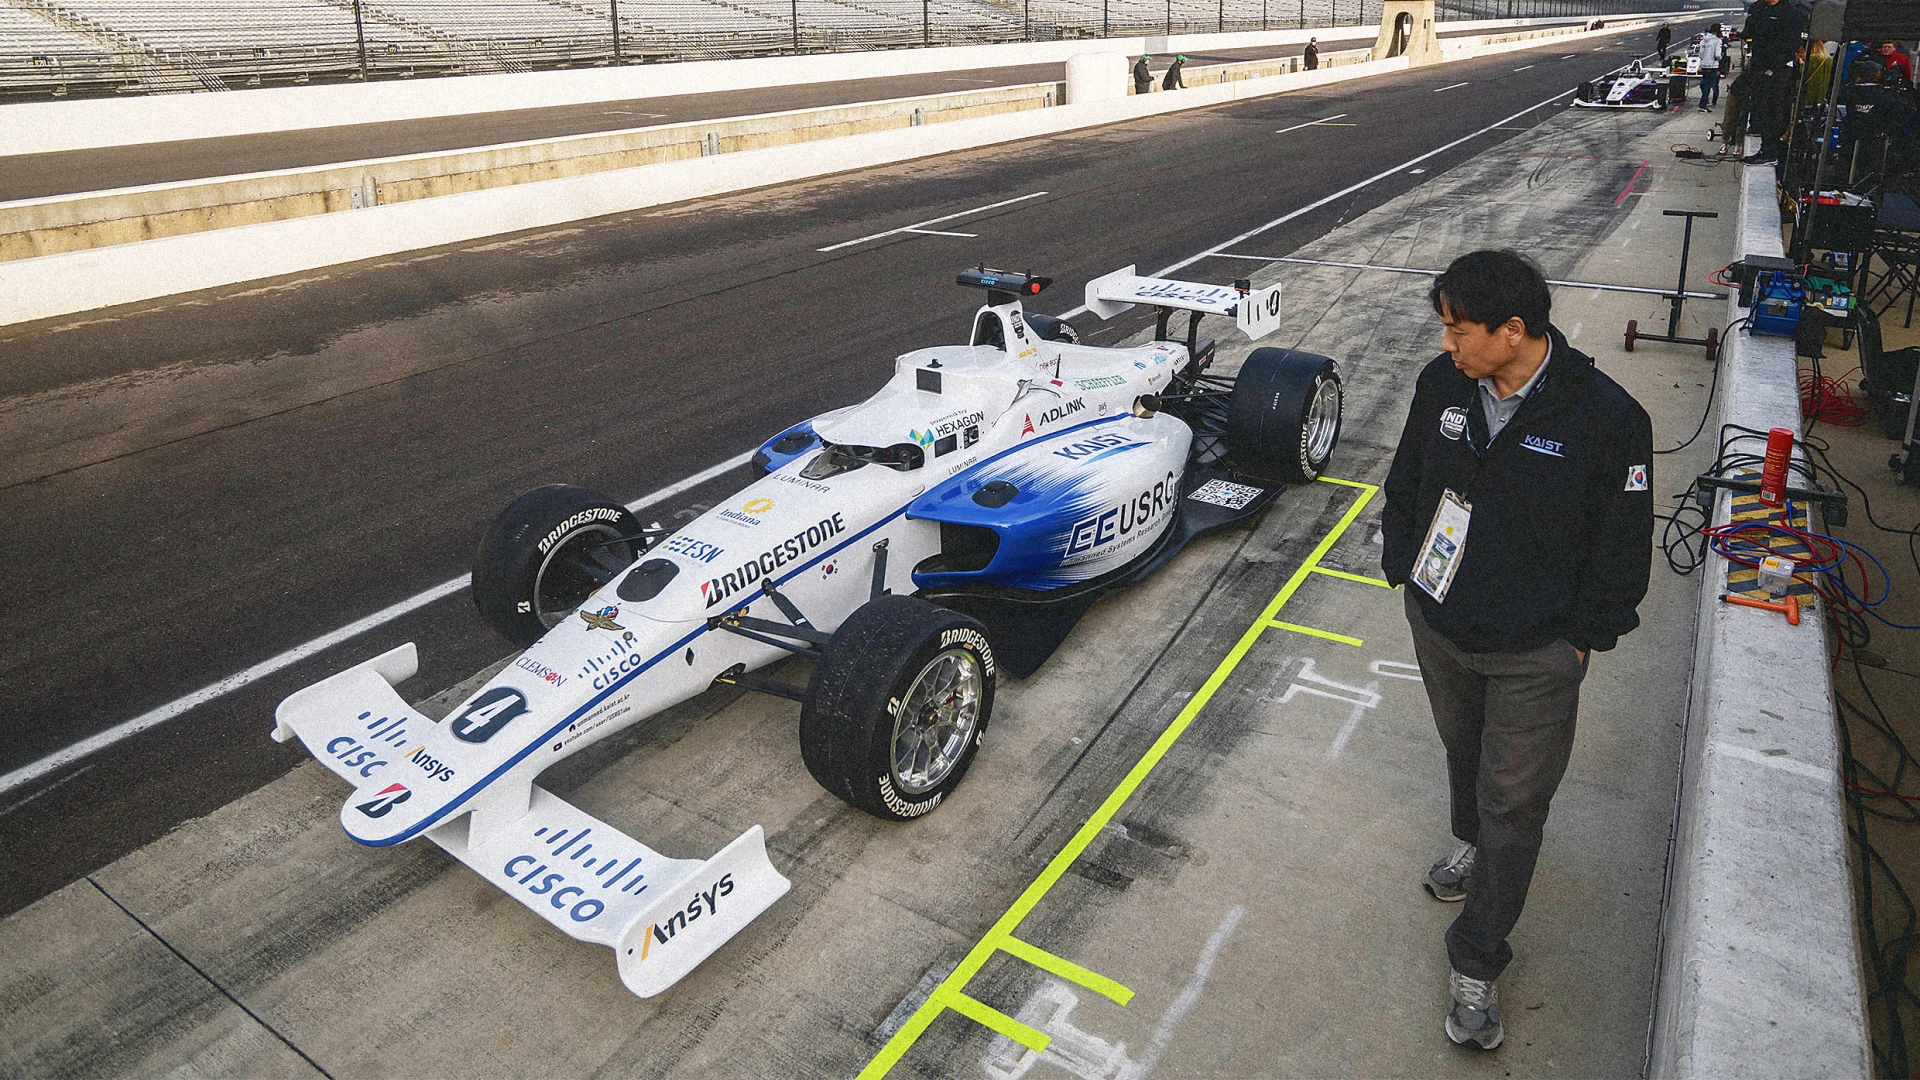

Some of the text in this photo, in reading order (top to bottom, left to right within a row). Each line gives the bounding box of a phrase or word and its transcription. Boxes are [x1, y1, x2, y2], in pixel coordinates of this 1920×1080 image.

[1135, 291, 1217, 304] CISCO
[935, 411, 984, 437] HEXAGON
[1039, 397, 1086, 427] ADLINK
[1053, 433, 1132, 460] KAIST
[1524, 434, 1563, 452] KAIST
[773, 473, 831, 494] LUMINAR
[537, 507, 622, 555] BRIDGESTONE
[719, 509, 760, 526] Indiana
[681, 540, 725, 564] ESN
[1107, 534, 1136, 552] Systems
[1137, 518, 1161, 538] Research
[700, 512, 846, 609] BRIDGESTONE
[940, 628, 995, 677] BRIDGESTONE
[592, 653, 642, 690] CISCO
[461, 694, 521, 734] 4
[404, 745, 455, 782] Ansys
[503, 855, 605, 922] CISCO
[641, 873, 734, 962] Ansys
